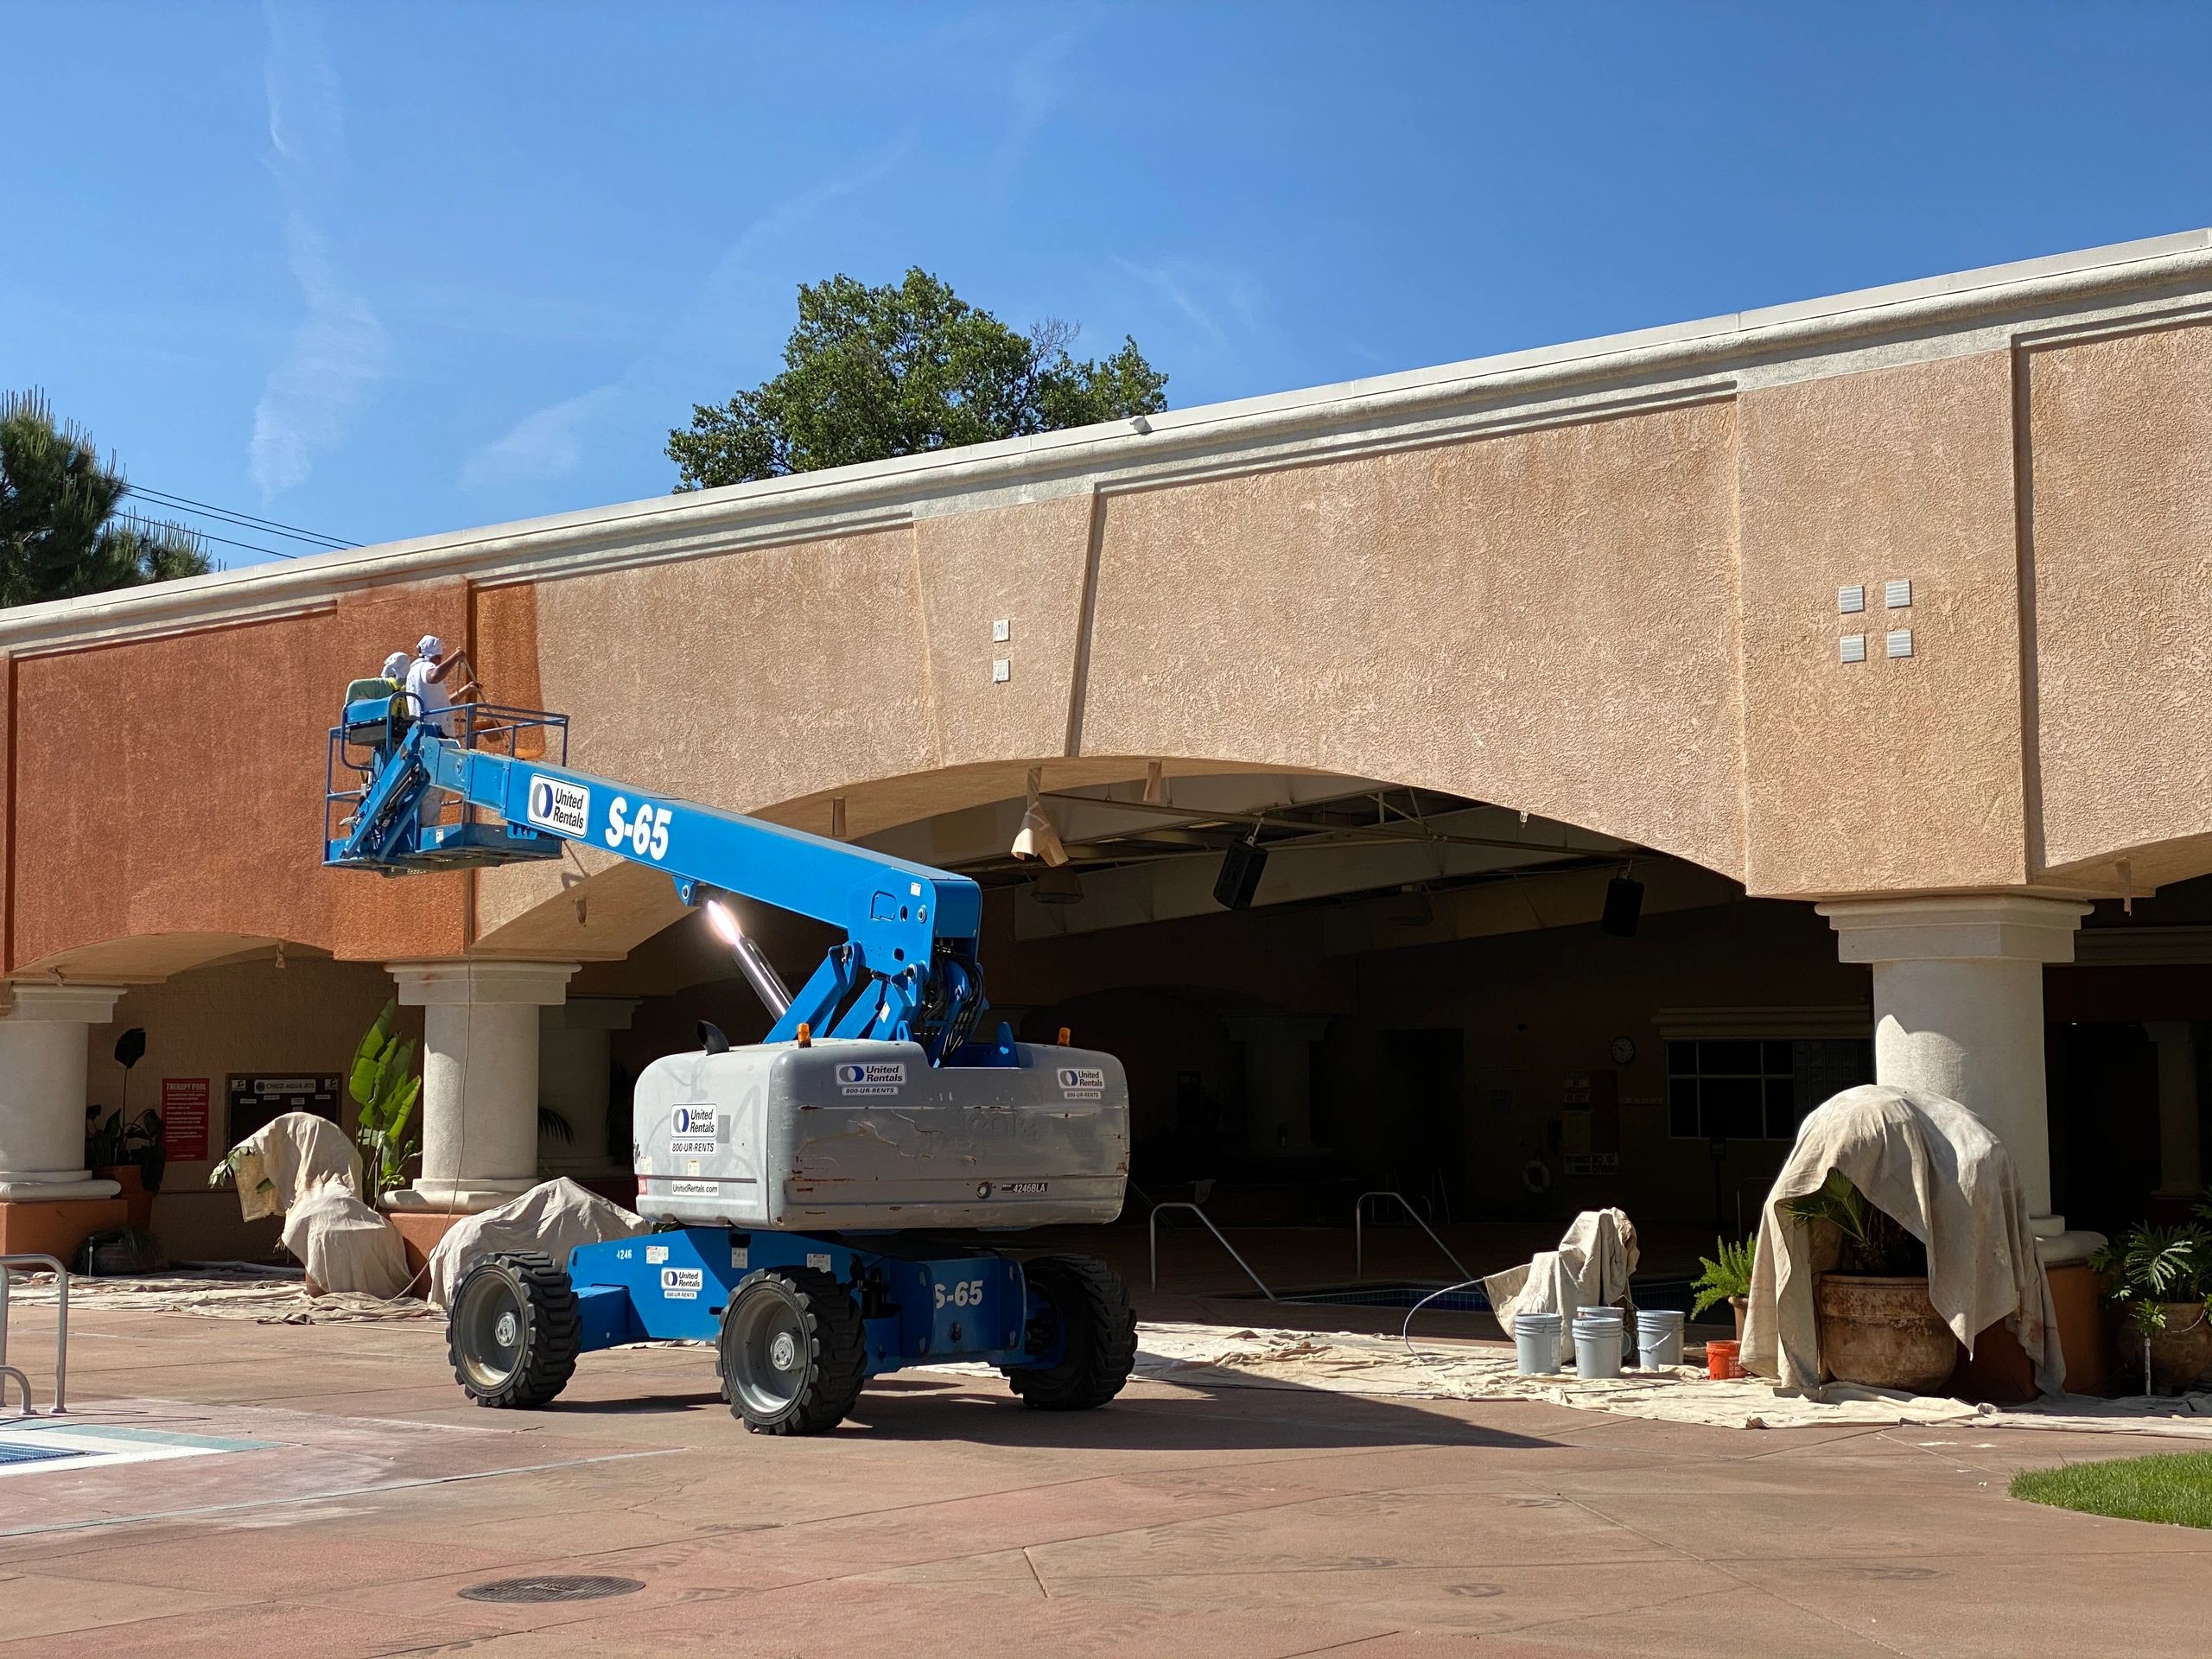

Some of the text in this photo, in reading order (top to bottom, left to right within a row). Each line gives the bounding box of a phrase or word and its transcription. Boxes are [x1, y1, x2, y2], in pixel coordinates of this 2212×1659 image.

[555, 788, 584, 810] United
[553, 806, 584, 830] Rentals
[605, 796, 672, 861] S-65
[1079, 1078, 1103, 1087] Rentals
[690, 1109, 713, 1120] United
[690, 1122, 715, 1133] Rentals
[672, 1142, 714, 1152] 800-UR-RENTS
[672, 1184, 717, 1193] UnitedRentals.com
[616, 1249, 632, 1260] 4246
[678, 1271, 699, 1280] United
[934, 1280, 983, 1309] S-65
